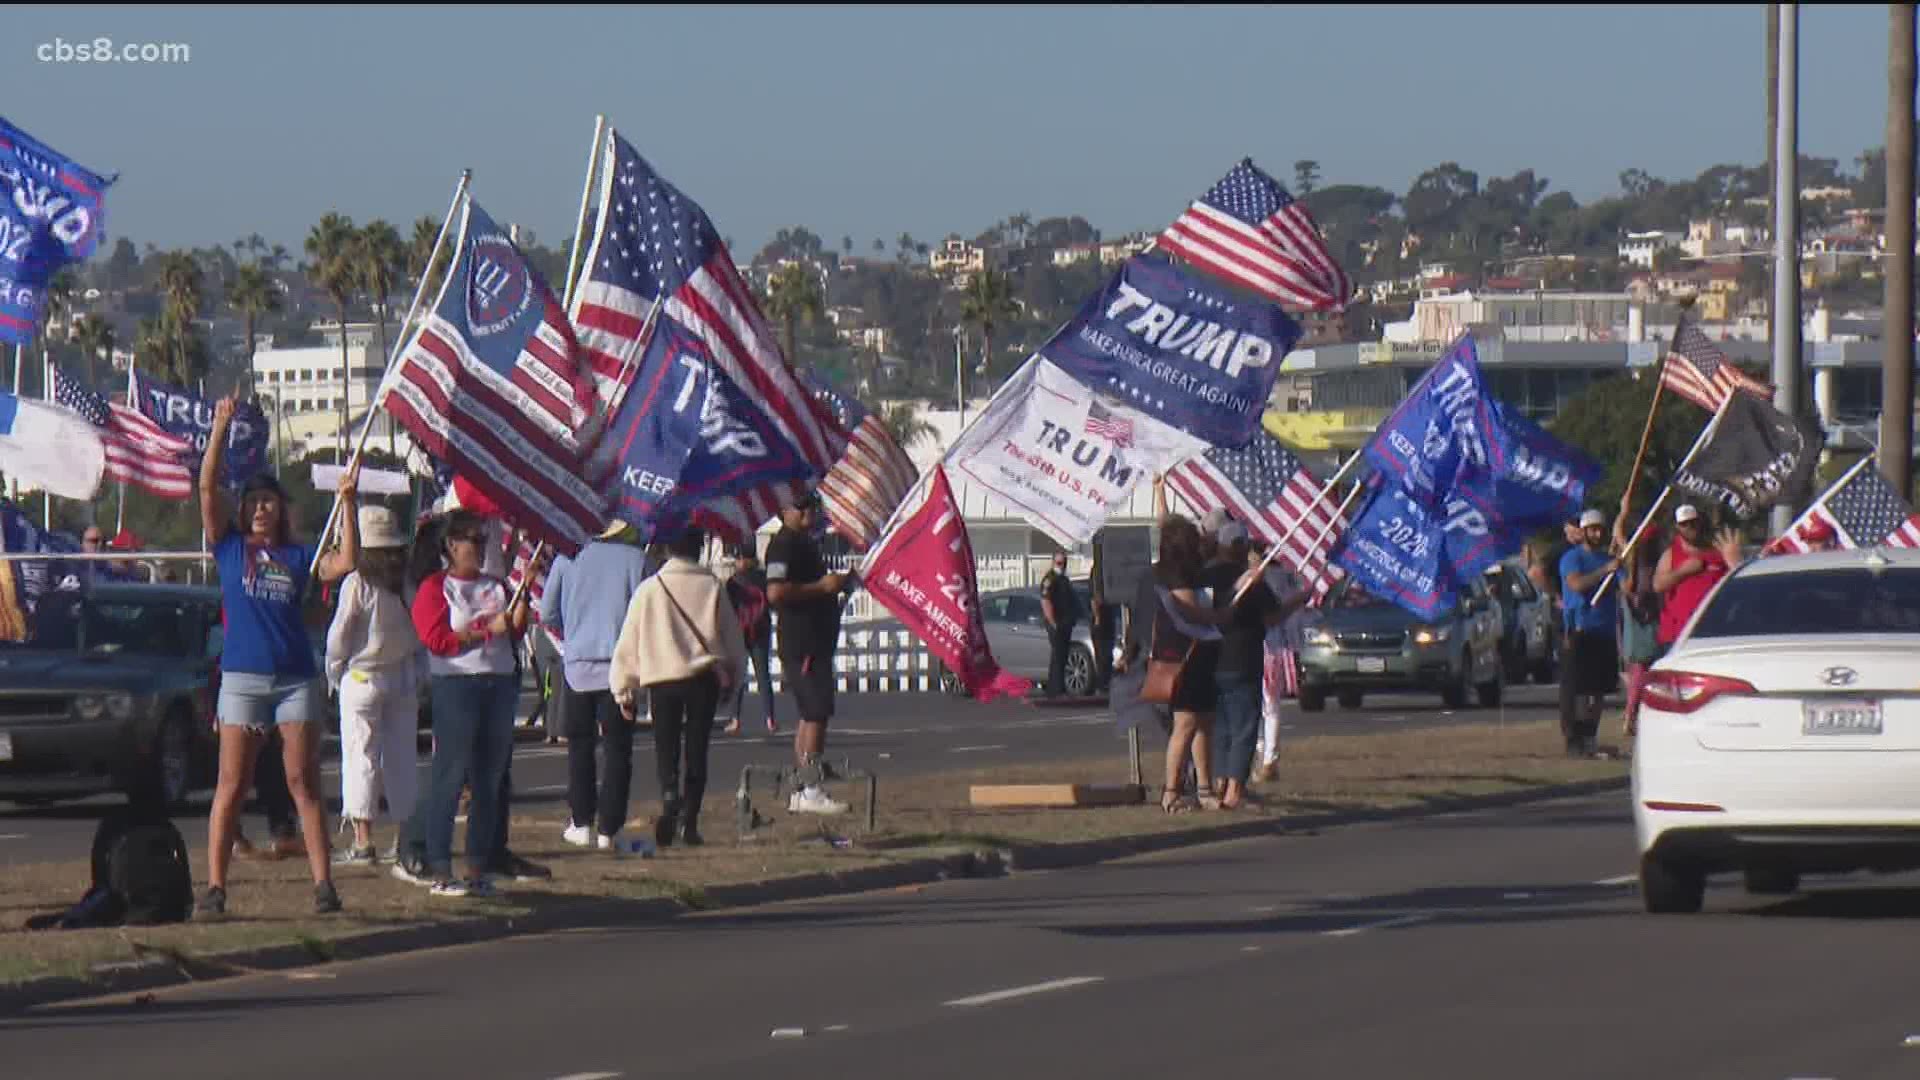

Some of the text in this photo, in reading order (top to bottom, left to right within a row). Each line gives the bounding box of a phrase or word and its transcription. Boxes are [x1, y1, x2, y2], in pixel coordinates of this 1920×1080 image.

[1105, 280, 1273, 379] TRUMP
[1152, 361, 1198, 394] GREAT
[149, 388, 253, 449] TRUP
[1035, 419, 1134, 488] TRUM
[885, 570, 970, 647] MAKE AMERIC
